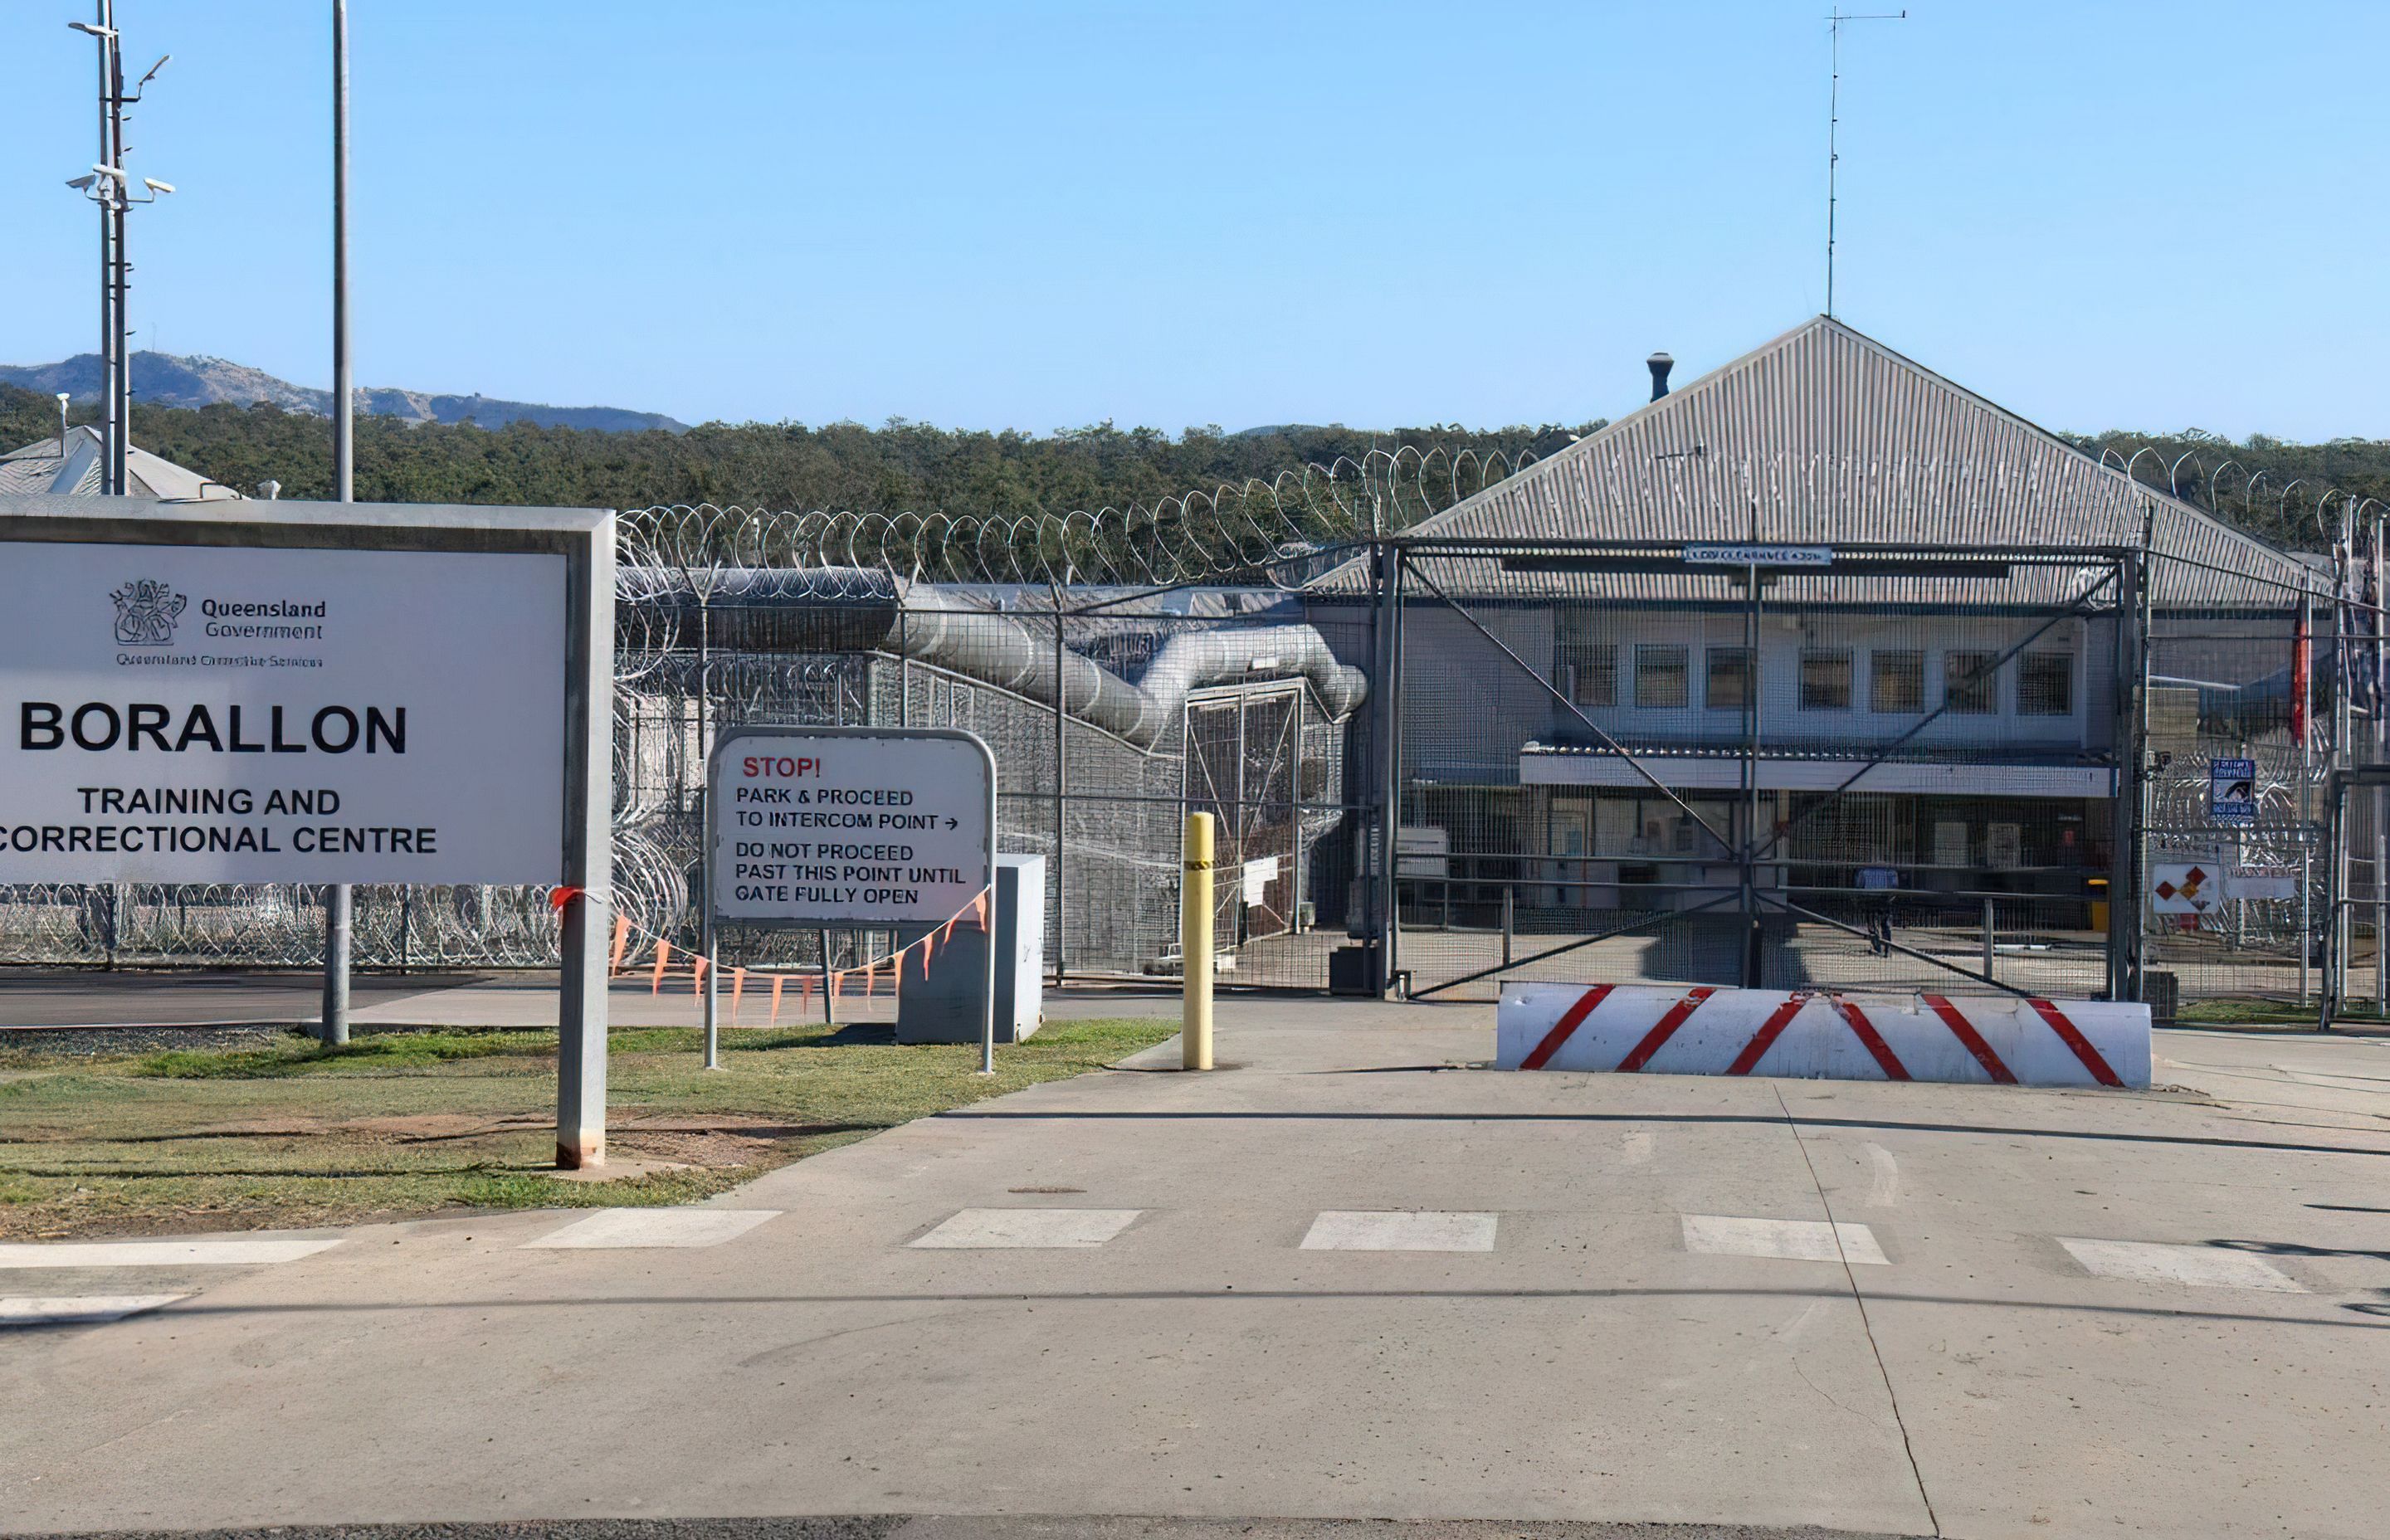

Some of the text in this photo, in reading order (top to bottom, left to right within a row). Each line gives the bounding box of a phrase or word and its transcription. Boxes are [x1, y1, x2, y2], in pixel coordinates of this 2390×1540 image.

[202, 599, 325, 618] Queensland
[206, 621, 322, 639] Government
[21, 702, 407, 754] BORALLON
[743, 757, 820, 777] STOP!
[77, 787, 339, 816] TRAINING AND
[736, 787, 913, 806] PARK & PROCEED
[736, 811, 939, 830] TO INTERCOM POINT
[293, 827, 437, 854] CENTRE
[736, 842, 913, 860] DO NOT PROCEED
[736, 864, 966, 884] PAST THIS POINT UNTIL
[735, 885, 919, 904] GATE FULLY OPEN
